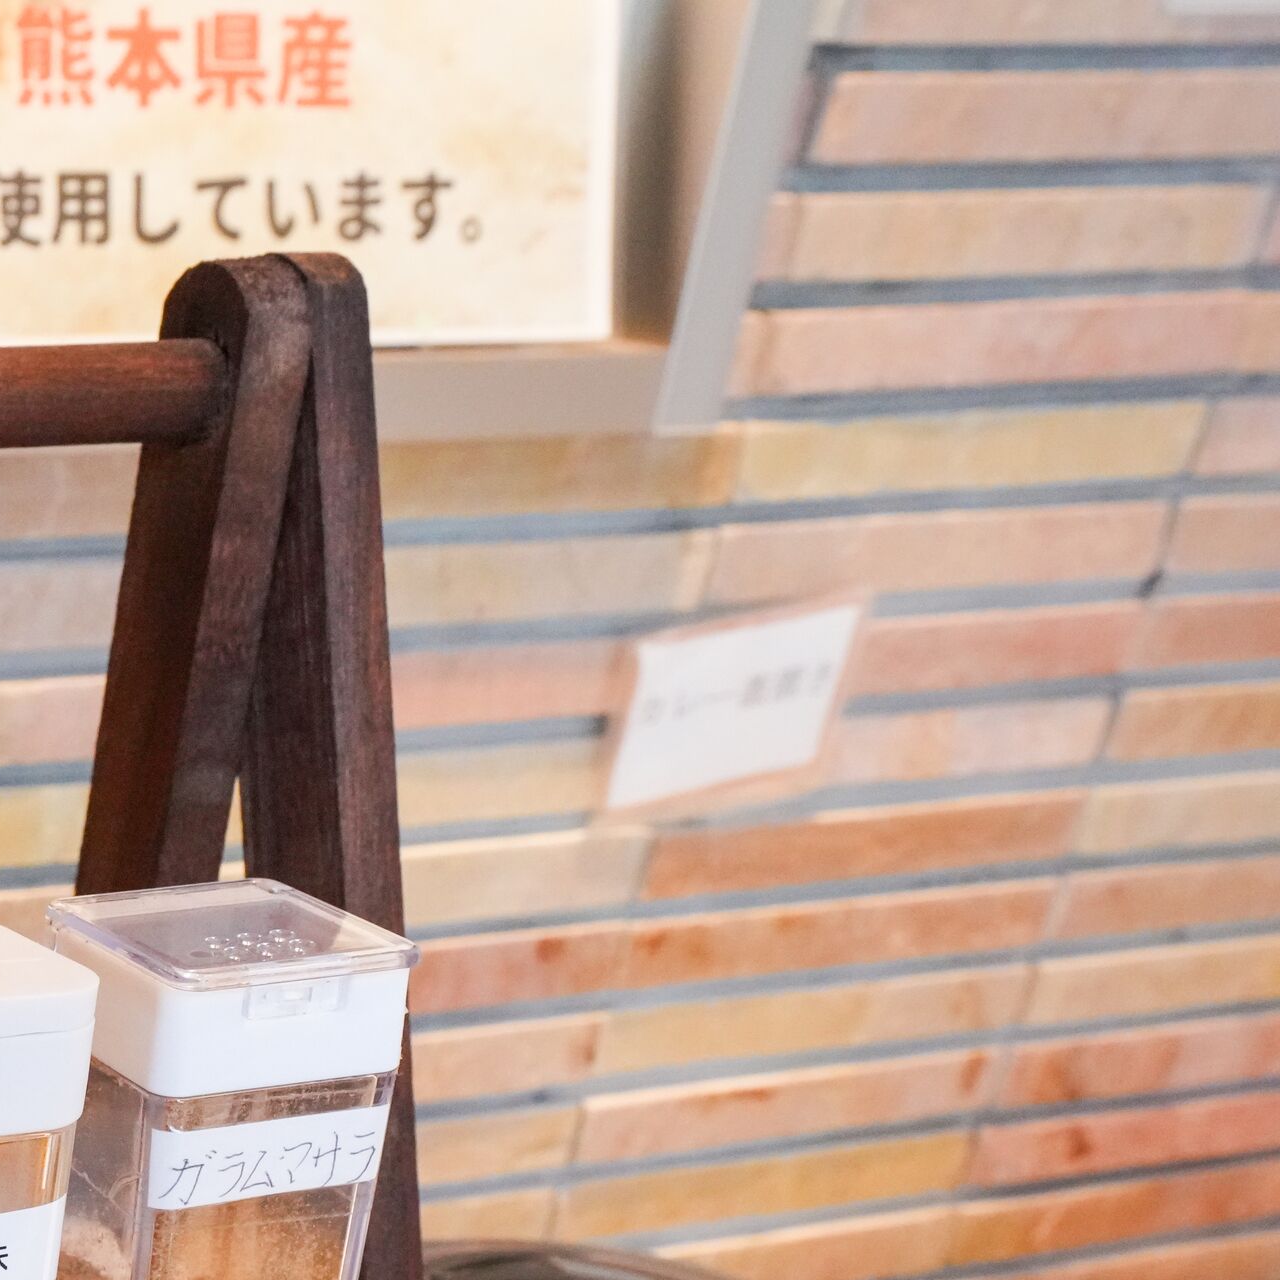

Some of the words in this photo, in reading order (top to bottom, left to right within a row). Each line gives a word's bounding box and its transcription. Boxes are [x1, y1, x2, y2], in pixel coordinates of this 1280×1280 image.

[16, 6, 352, 107] 熊本県産
[158, 1131, 376, 1205] ガラムマサラ
